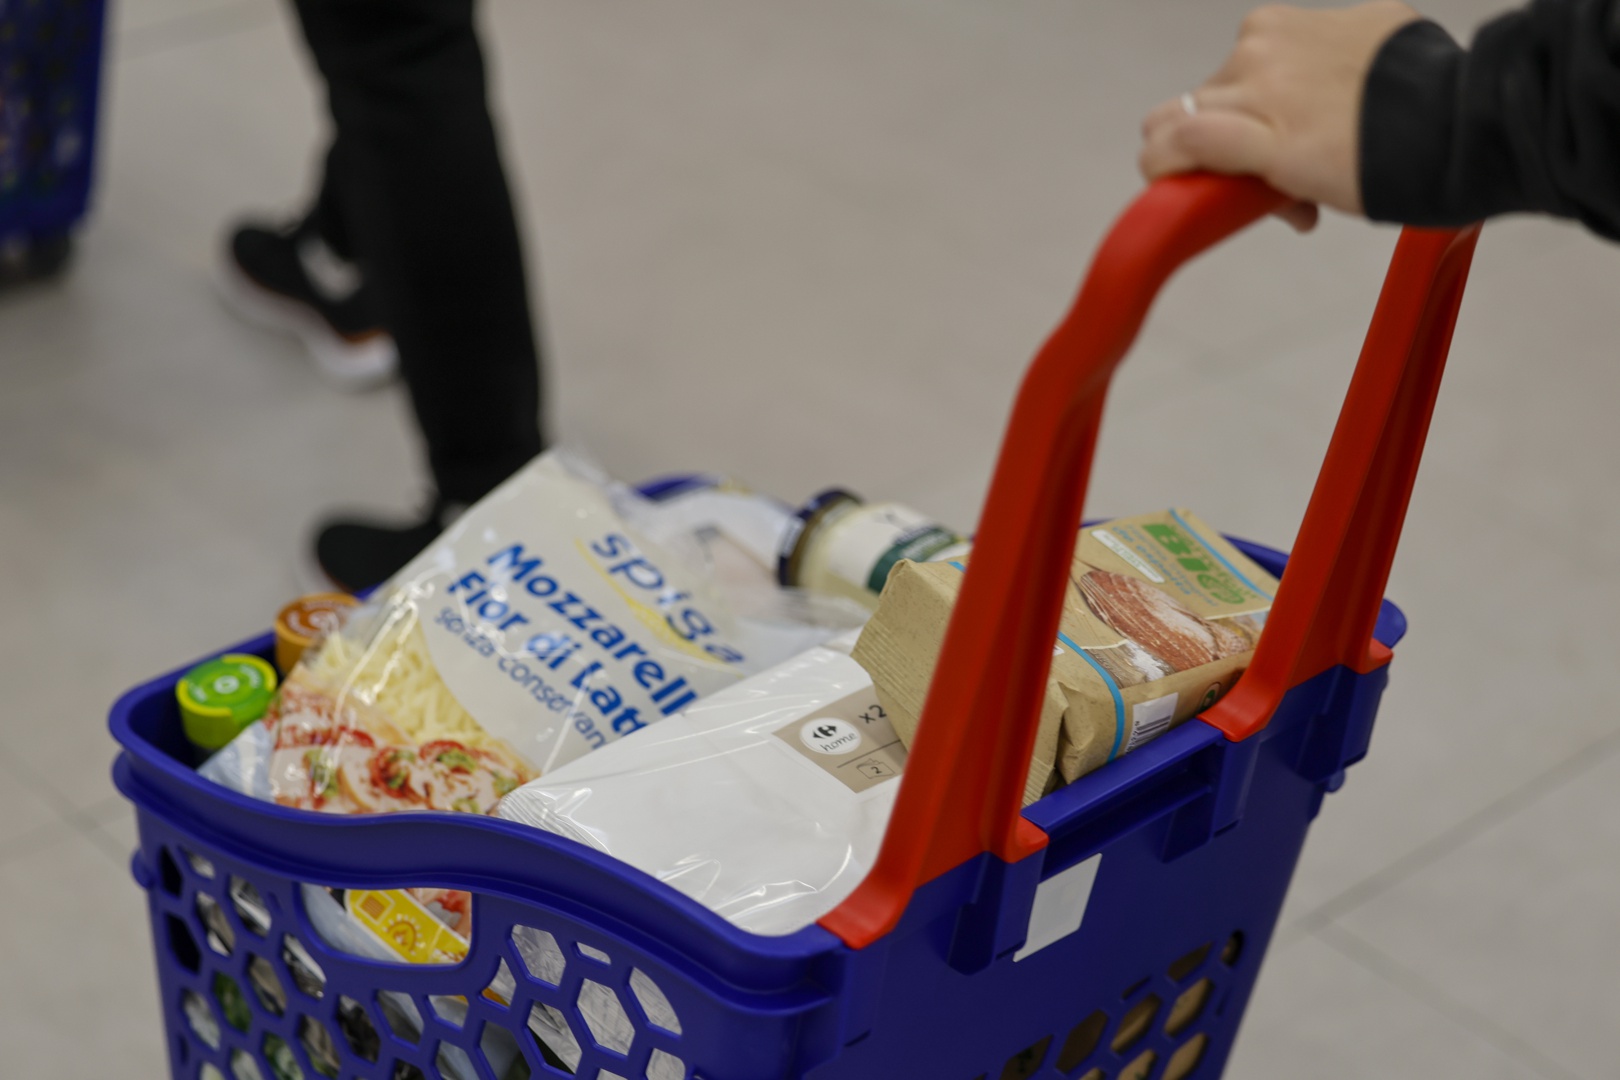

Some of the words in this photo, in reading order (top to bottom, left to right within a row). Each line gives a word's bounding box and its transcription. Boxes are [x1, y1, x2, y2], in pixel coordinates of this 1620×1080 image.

[446, 569, 530, 632] Fior
[525, 631, 583, 671] di
[486, 542, 699, 716] Mozzarell
[819, 731, 858, 752] home
[870, 766, 883, 775] 2
